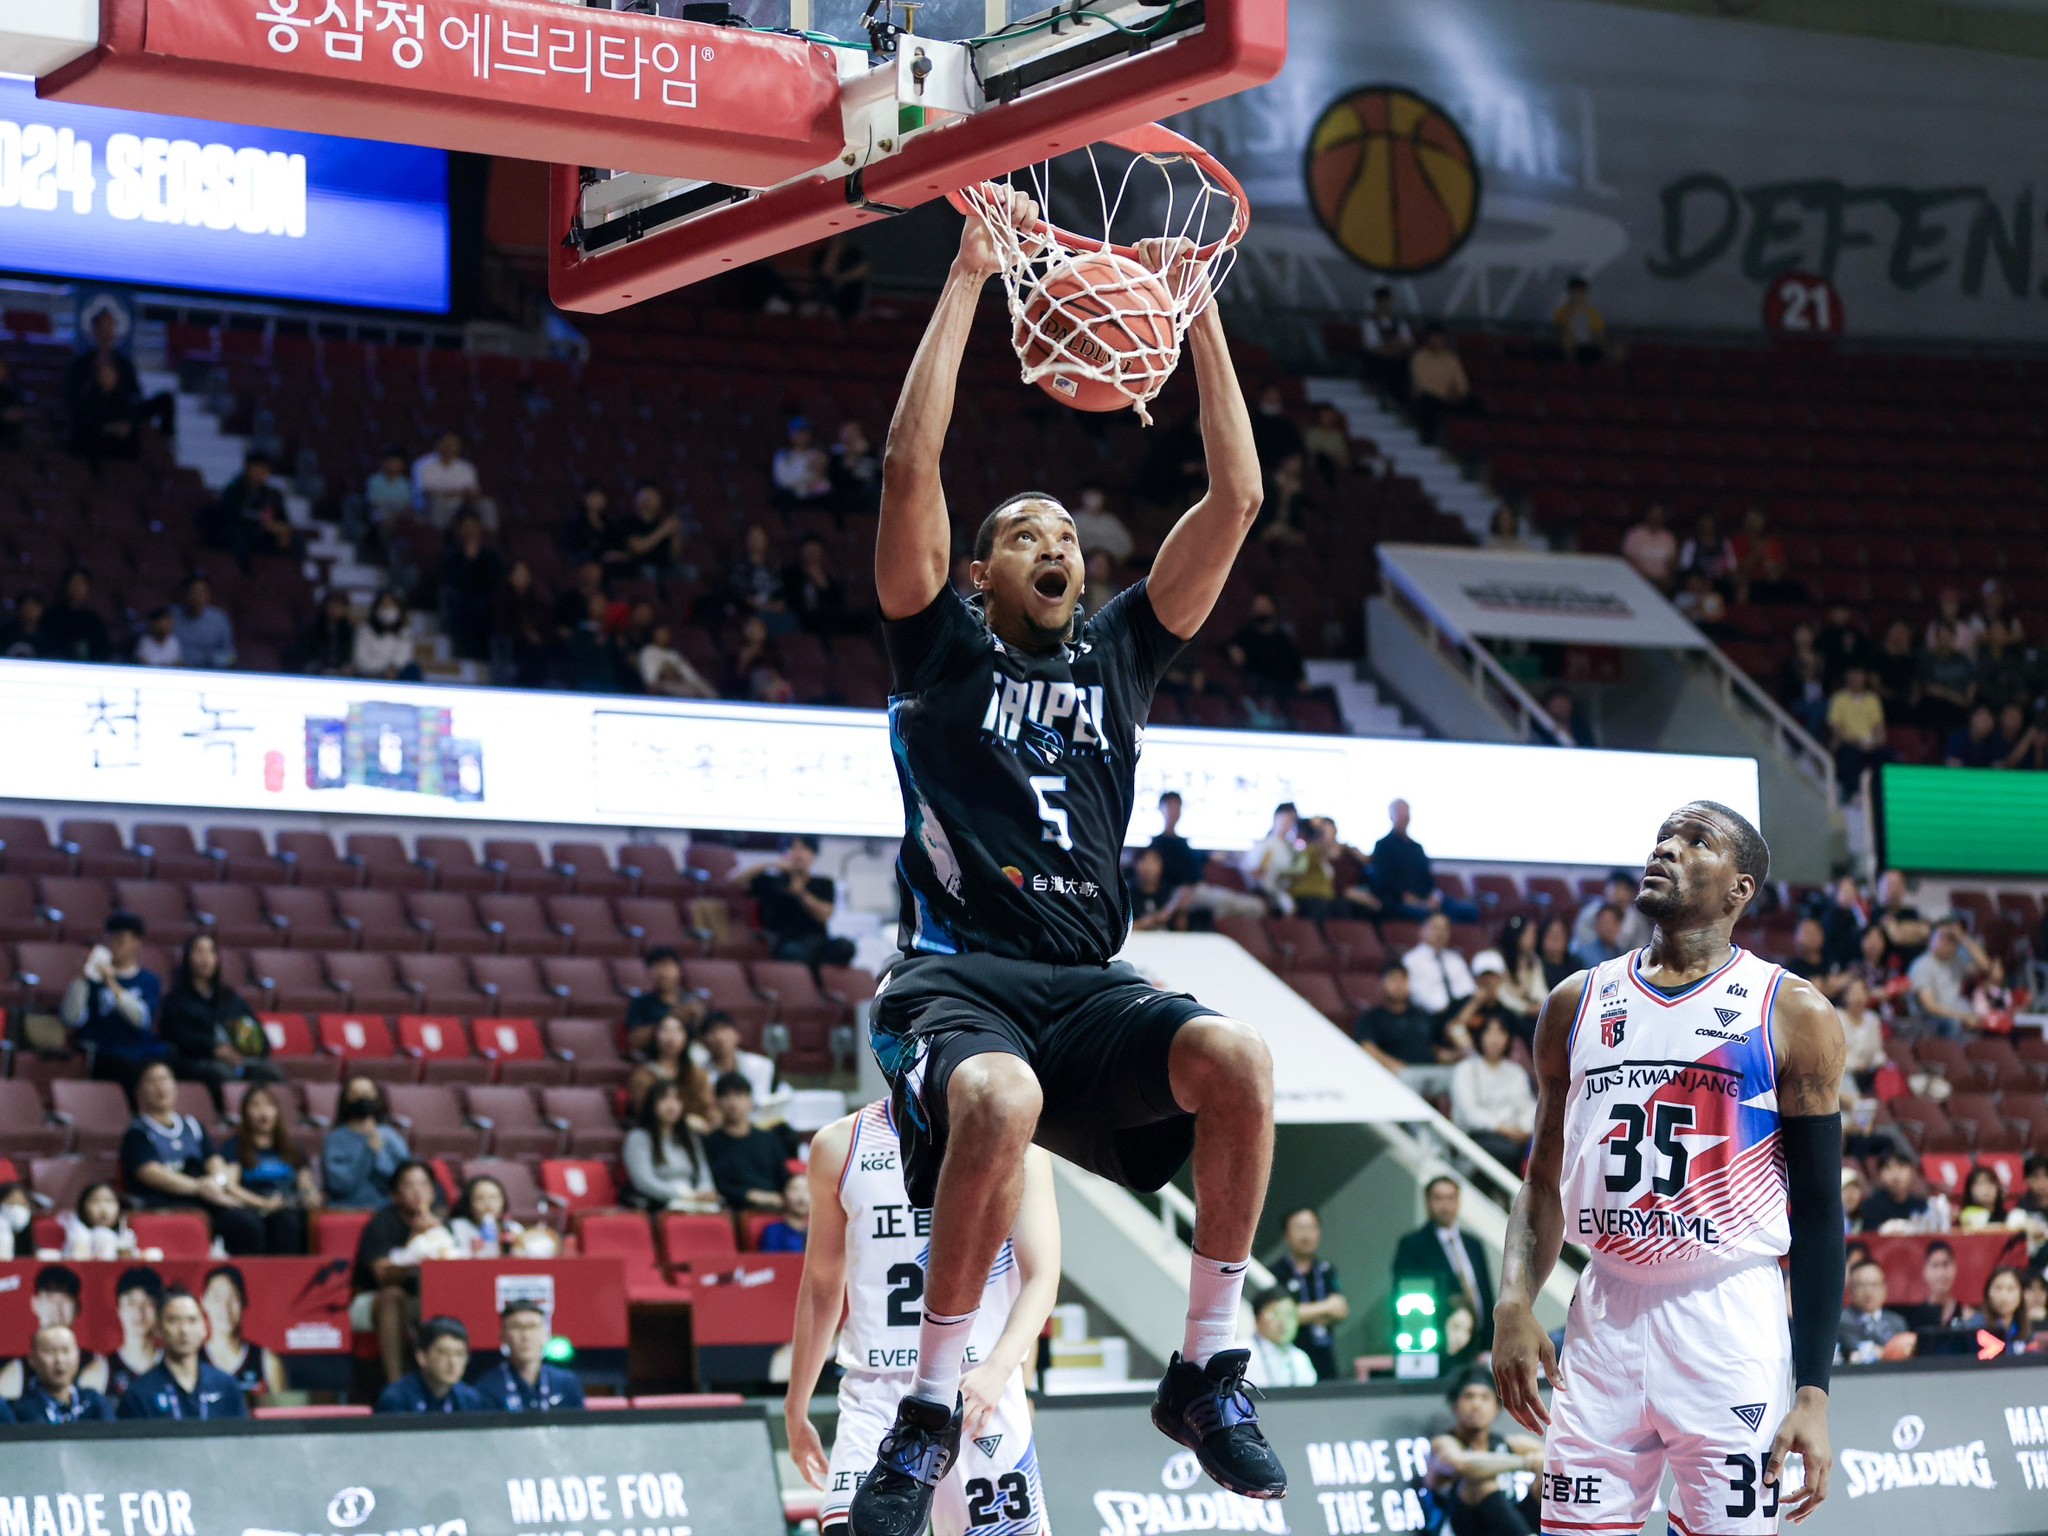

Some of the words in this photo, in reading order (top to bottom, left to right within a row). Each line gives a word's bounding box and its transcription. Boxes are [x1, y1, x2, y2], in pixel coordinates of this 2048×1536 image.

[0, 121, 95, 214] 024
[106, 132, 307, 238] SEASON
[1645, 172, 2048, 297] DEFEN
[1780, 280, 1831, 331] 21
[1028, 774, 1075, 851] 5
[1695, 1028, 1749, 1043] CORALIAN
[1586, 1069, 1624, 1100] JUNG
[861, 1158, 895, 1171] KGC
[1605, 1103, 1694, 1198] 35
[872, 1204, 933, 1239] 正官
[1578, 1208, 1720, 1244] EVERYTIME
[887, 1263, 924, 1326] 2
[1306, 1439, 1396, 1487] MADE
[1395, 1437, 1432, 1482] FO
[1840, 1440, 1993, 1499] SPALDING
[0, 1494, 112, 1536] MADE
[119, 1488, 196, 1536] FOR
[507, 1474, 612, 1524] MADE
[617, 1472, 689, 1519] FOR
[965, 1471, 1031, 1528] 23
[1317, 1490, 1381, 1536] THE
[1381, 1488, 1426, 1532] GA
